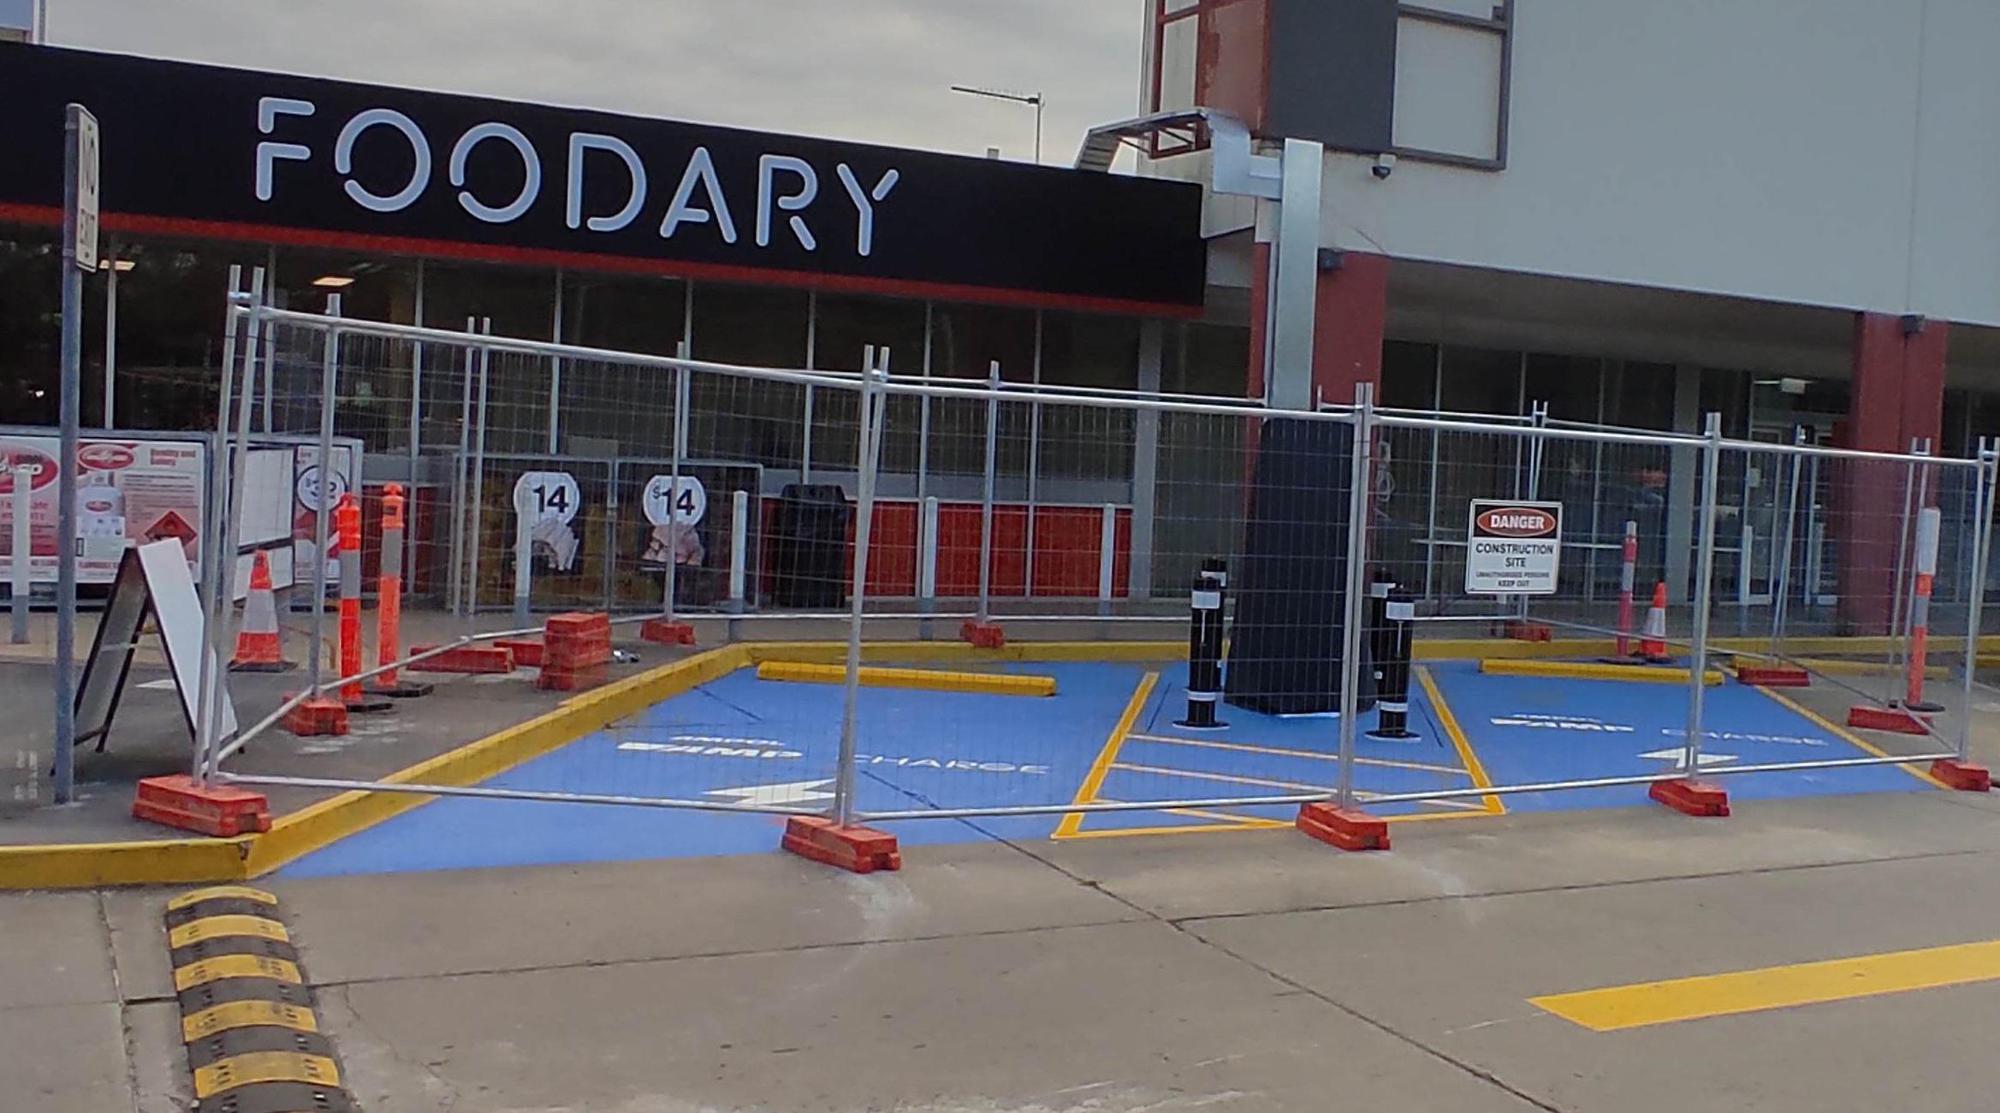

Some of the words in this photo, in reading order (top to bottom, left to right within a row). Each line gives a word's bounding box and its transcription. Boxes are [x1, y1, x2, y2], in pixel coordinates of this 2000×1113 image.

[256, 96, 899, 257] FOODARY
[652, 484, 695, 516] $14
[1490, 514, 1545, 530] DANGER
[1475, 543, 1553, 554] CONSTRUCTION
[1505, 557, 1526, 568] SITE
[618, 742, 803, 759] AMP
